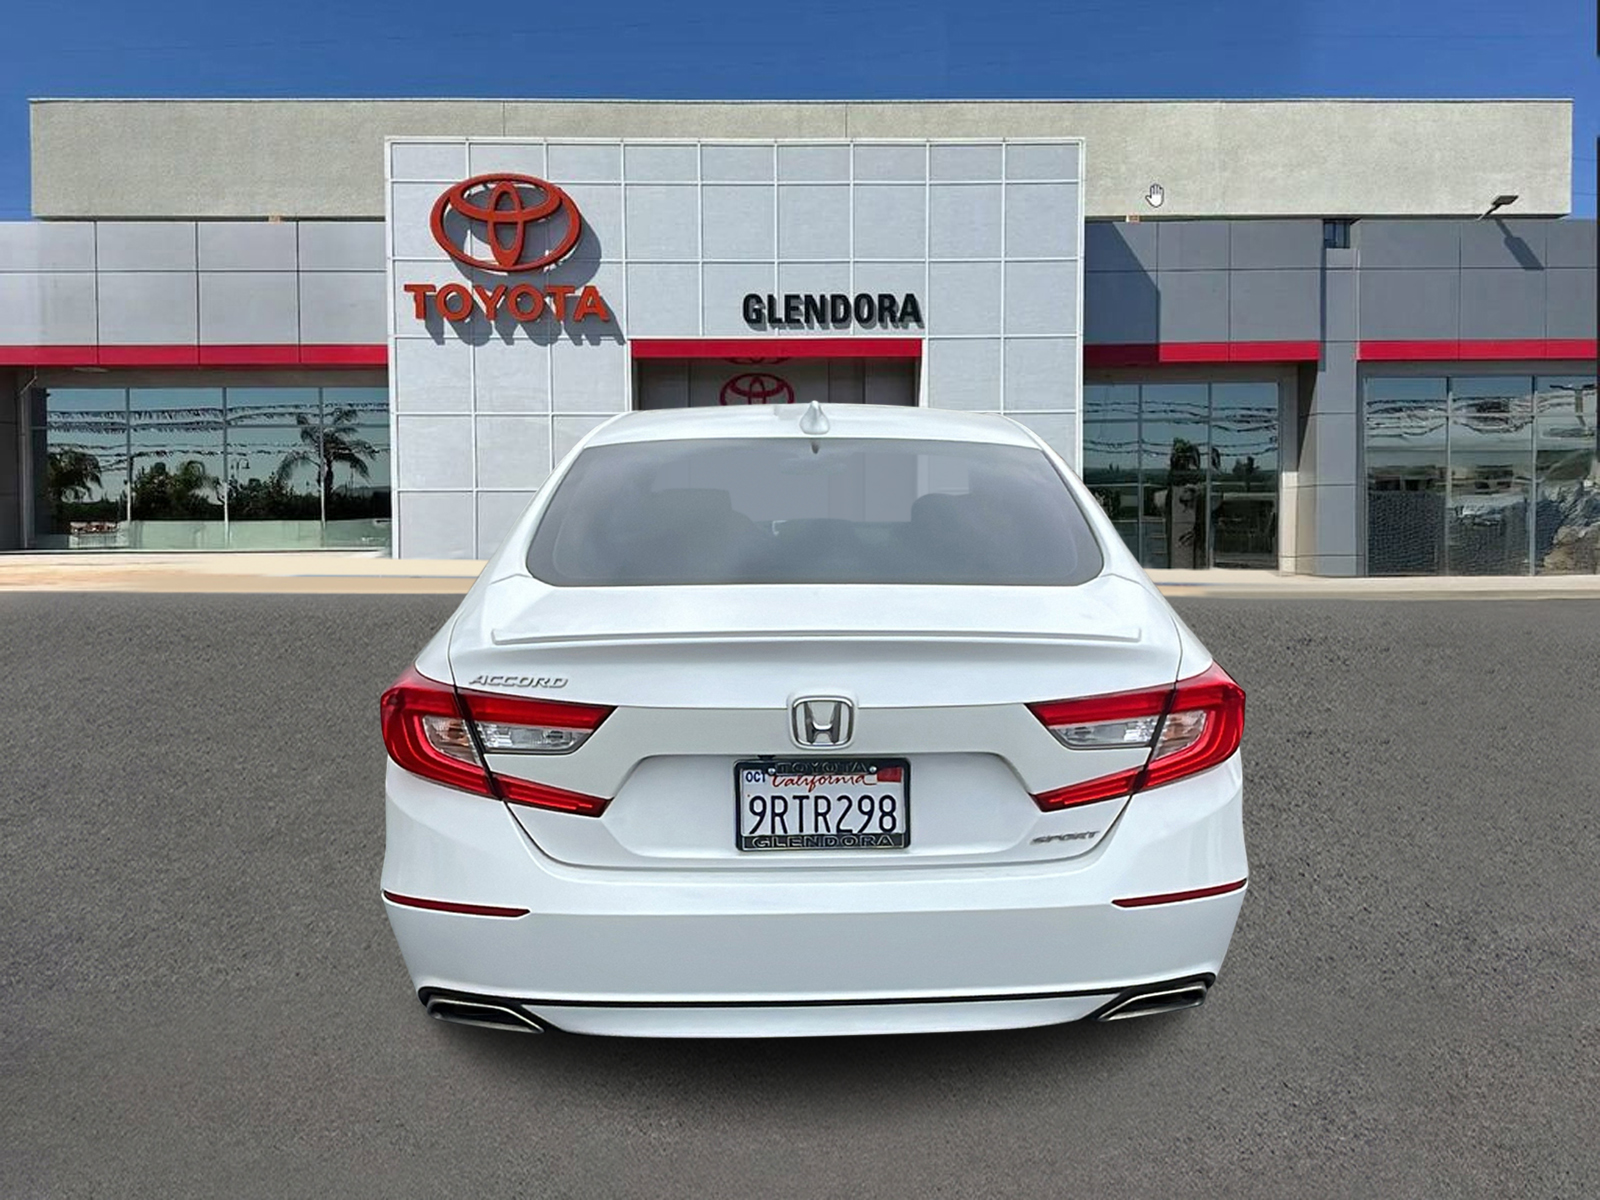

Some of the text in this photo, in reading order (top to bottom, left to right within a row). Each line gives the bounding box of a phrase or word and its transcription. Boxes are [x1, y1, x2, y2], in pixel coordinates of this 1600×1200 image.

[404, 283, 610, 323] TOYOTA
[742, 293, 922, 326] GLENDORA
[468, 674, 569, 689] ACCORD
[776, 761, 867, 774] TOYOTA
[771, 775, 877, 793] California
[748, 794, 898, 835] 9RTR298
[751, 834, 895, 848] GLENDORA
[1030, 831, 1099, 844] SPORT
